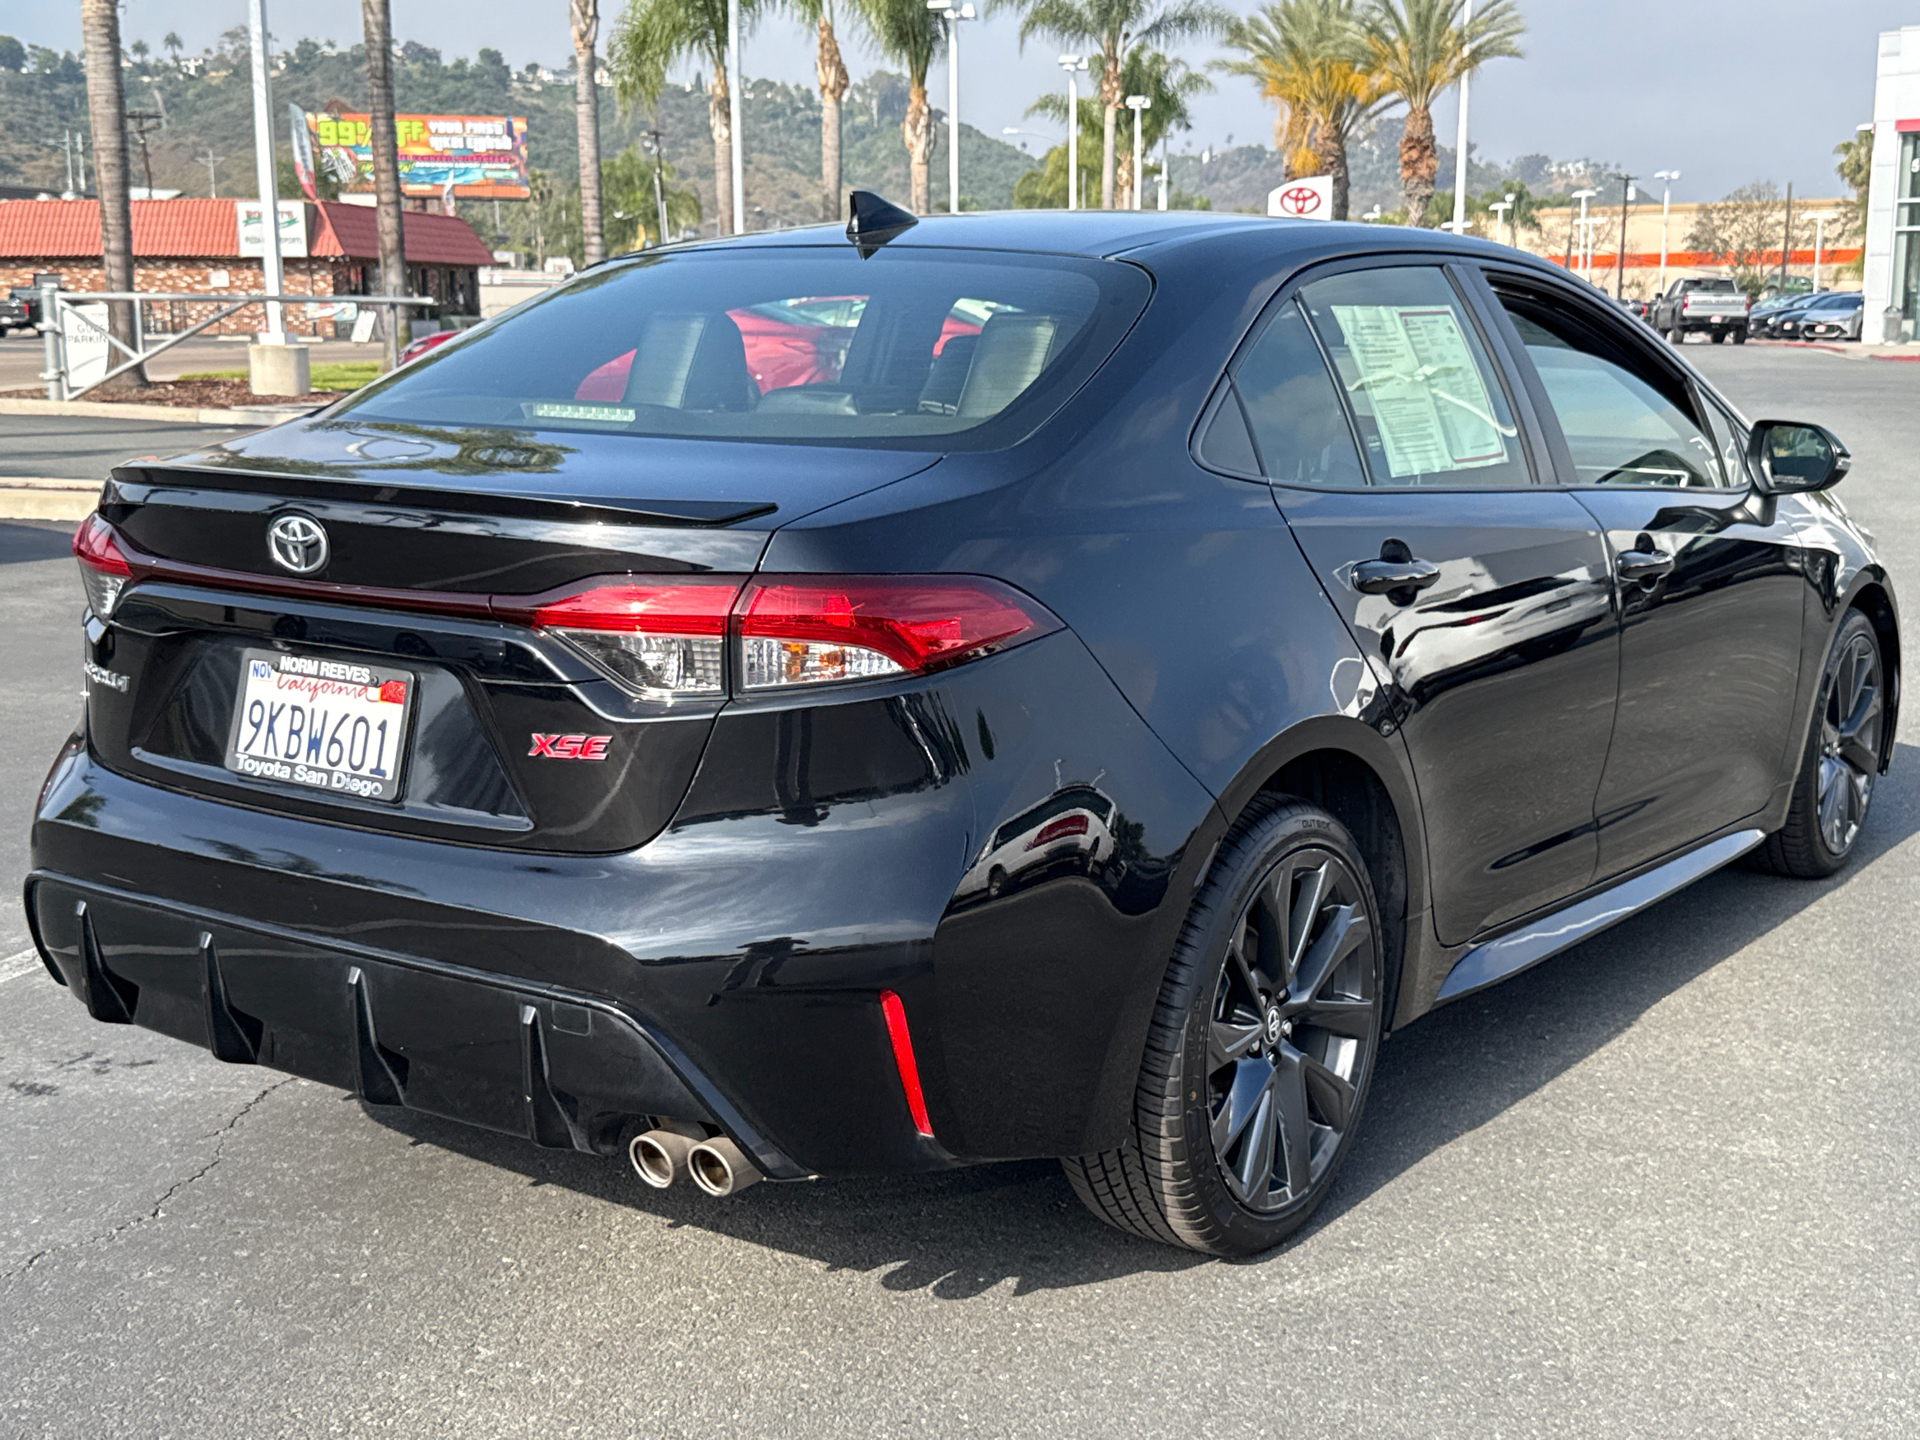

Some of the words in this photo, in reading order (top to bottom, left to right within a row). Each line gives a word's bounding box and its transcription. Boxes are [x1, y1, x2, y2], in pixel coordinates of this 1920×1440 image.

[395, 120, 423, 148] FF
[428, 121, 463, 134] YOUR
[465, 121, 504, 135] FIRST
[252, 662, 272, 679] NOV
[280, 656, 318, 676] NORM
[320, 662, 371, 684] REEVES
[276, 672, 380, 703] California
[243, 699, 388, 778] 9KBW601
[527, 732, 613, 761] XSE
[235, 753, 292, 779] Toyota
[294, 764, 328, 786] San
[331, 771, 383, 797] Diego
